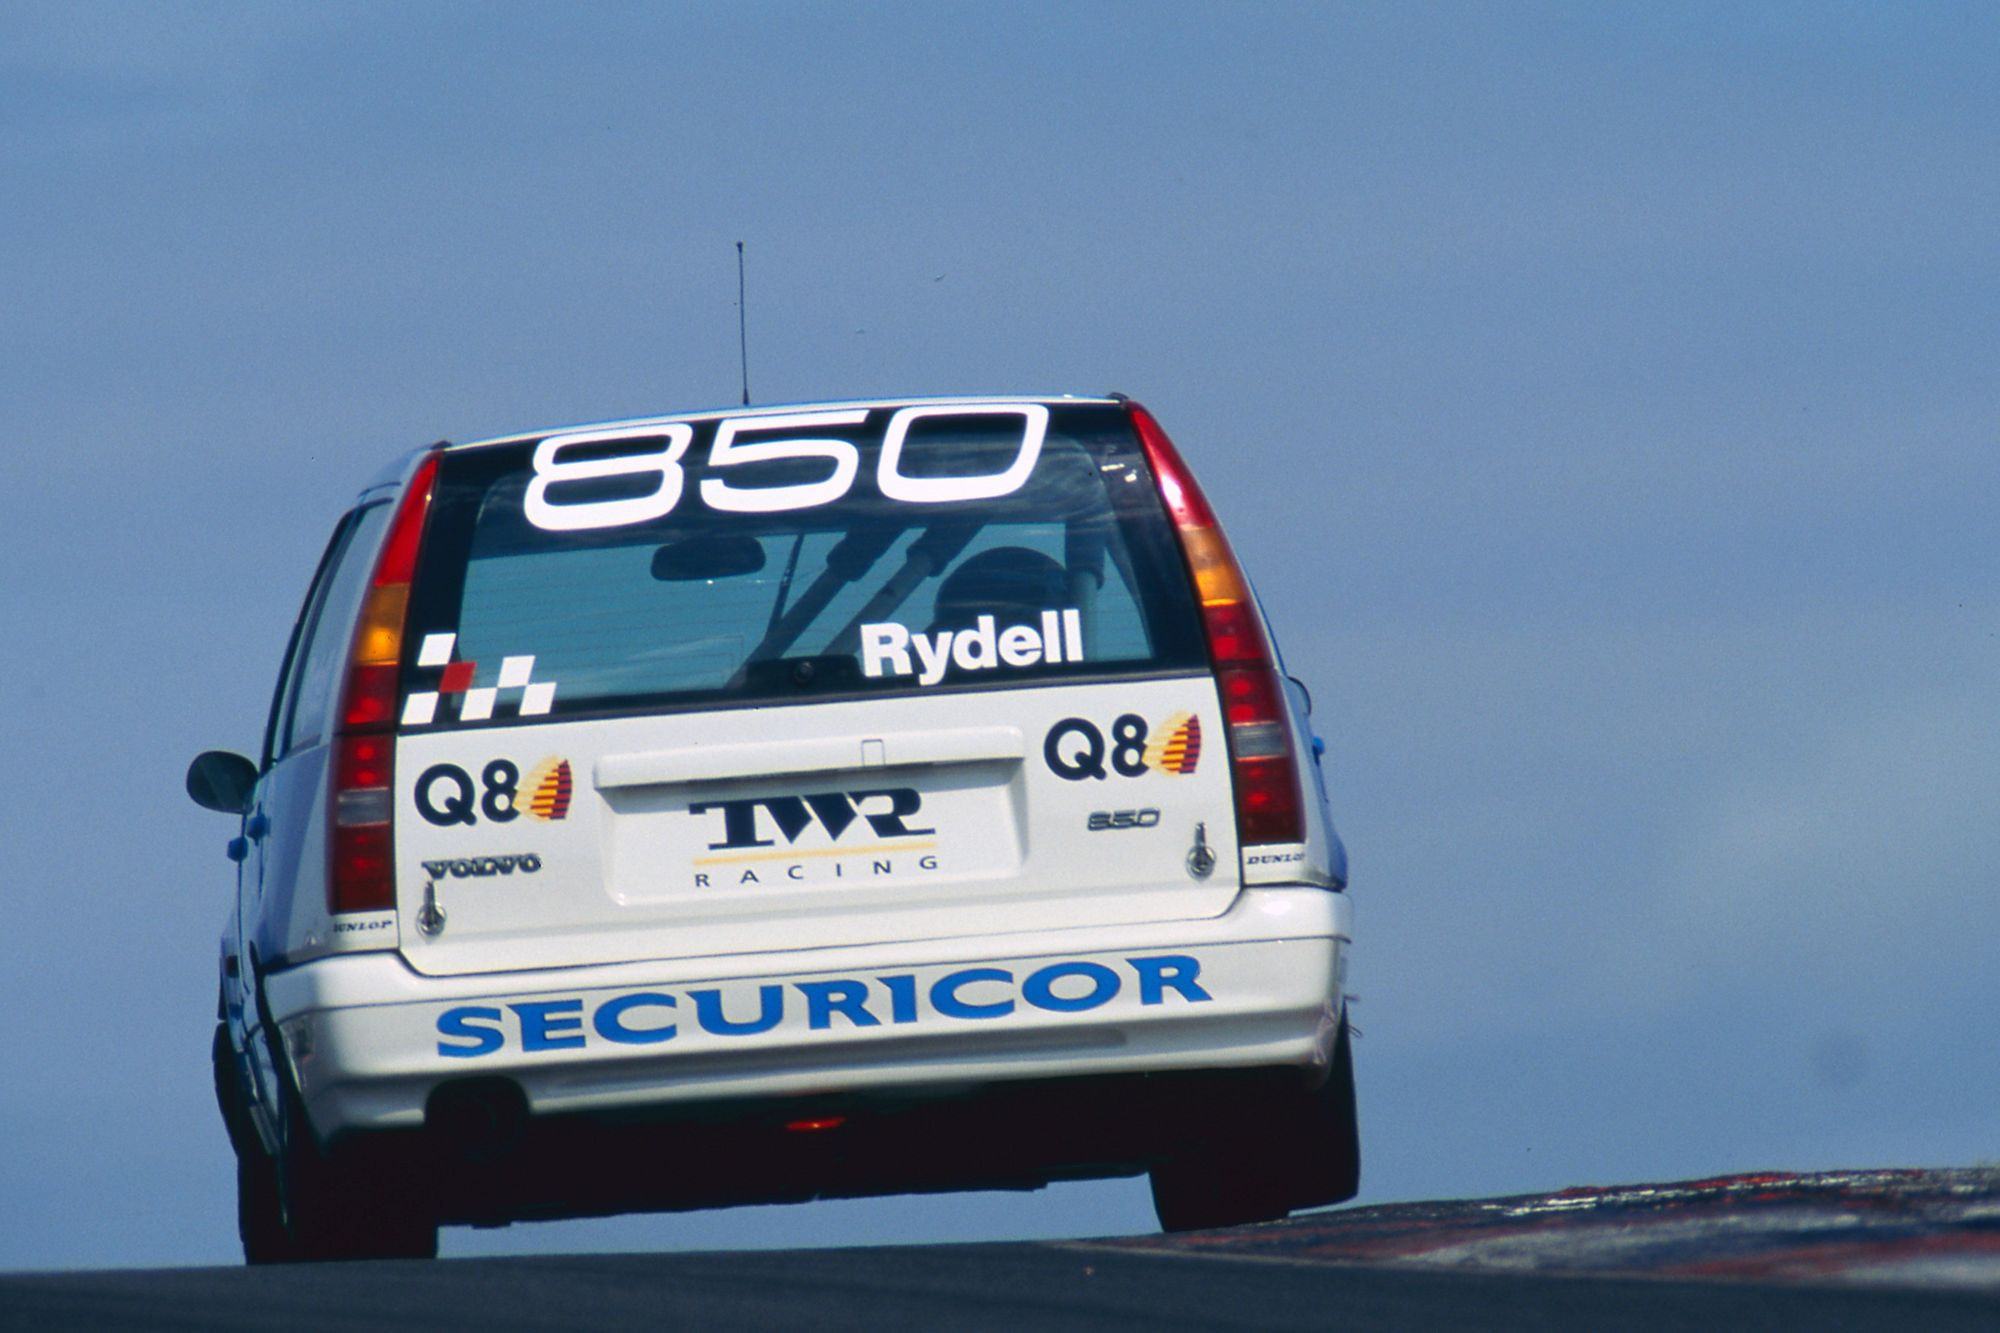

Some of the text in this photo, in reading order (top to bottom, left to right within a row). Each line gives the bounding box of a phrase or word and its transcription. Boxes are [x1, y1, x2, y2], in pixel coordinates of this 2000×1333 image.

[523, 403, 1050, 531] 850
[860, 608, 1084, 686] Rydell
[1043, 713, 1149, 781] Q8
[414, 758, 520, 826] Q8
[689, 788, 936, 850] TWR
[1087, 807, 1161, 832] 850
[421, 852, 542, 880] VOLVO
[695, 855, 938, 888] RACING
[437, 954, 1213, 1058] SECURICOR
